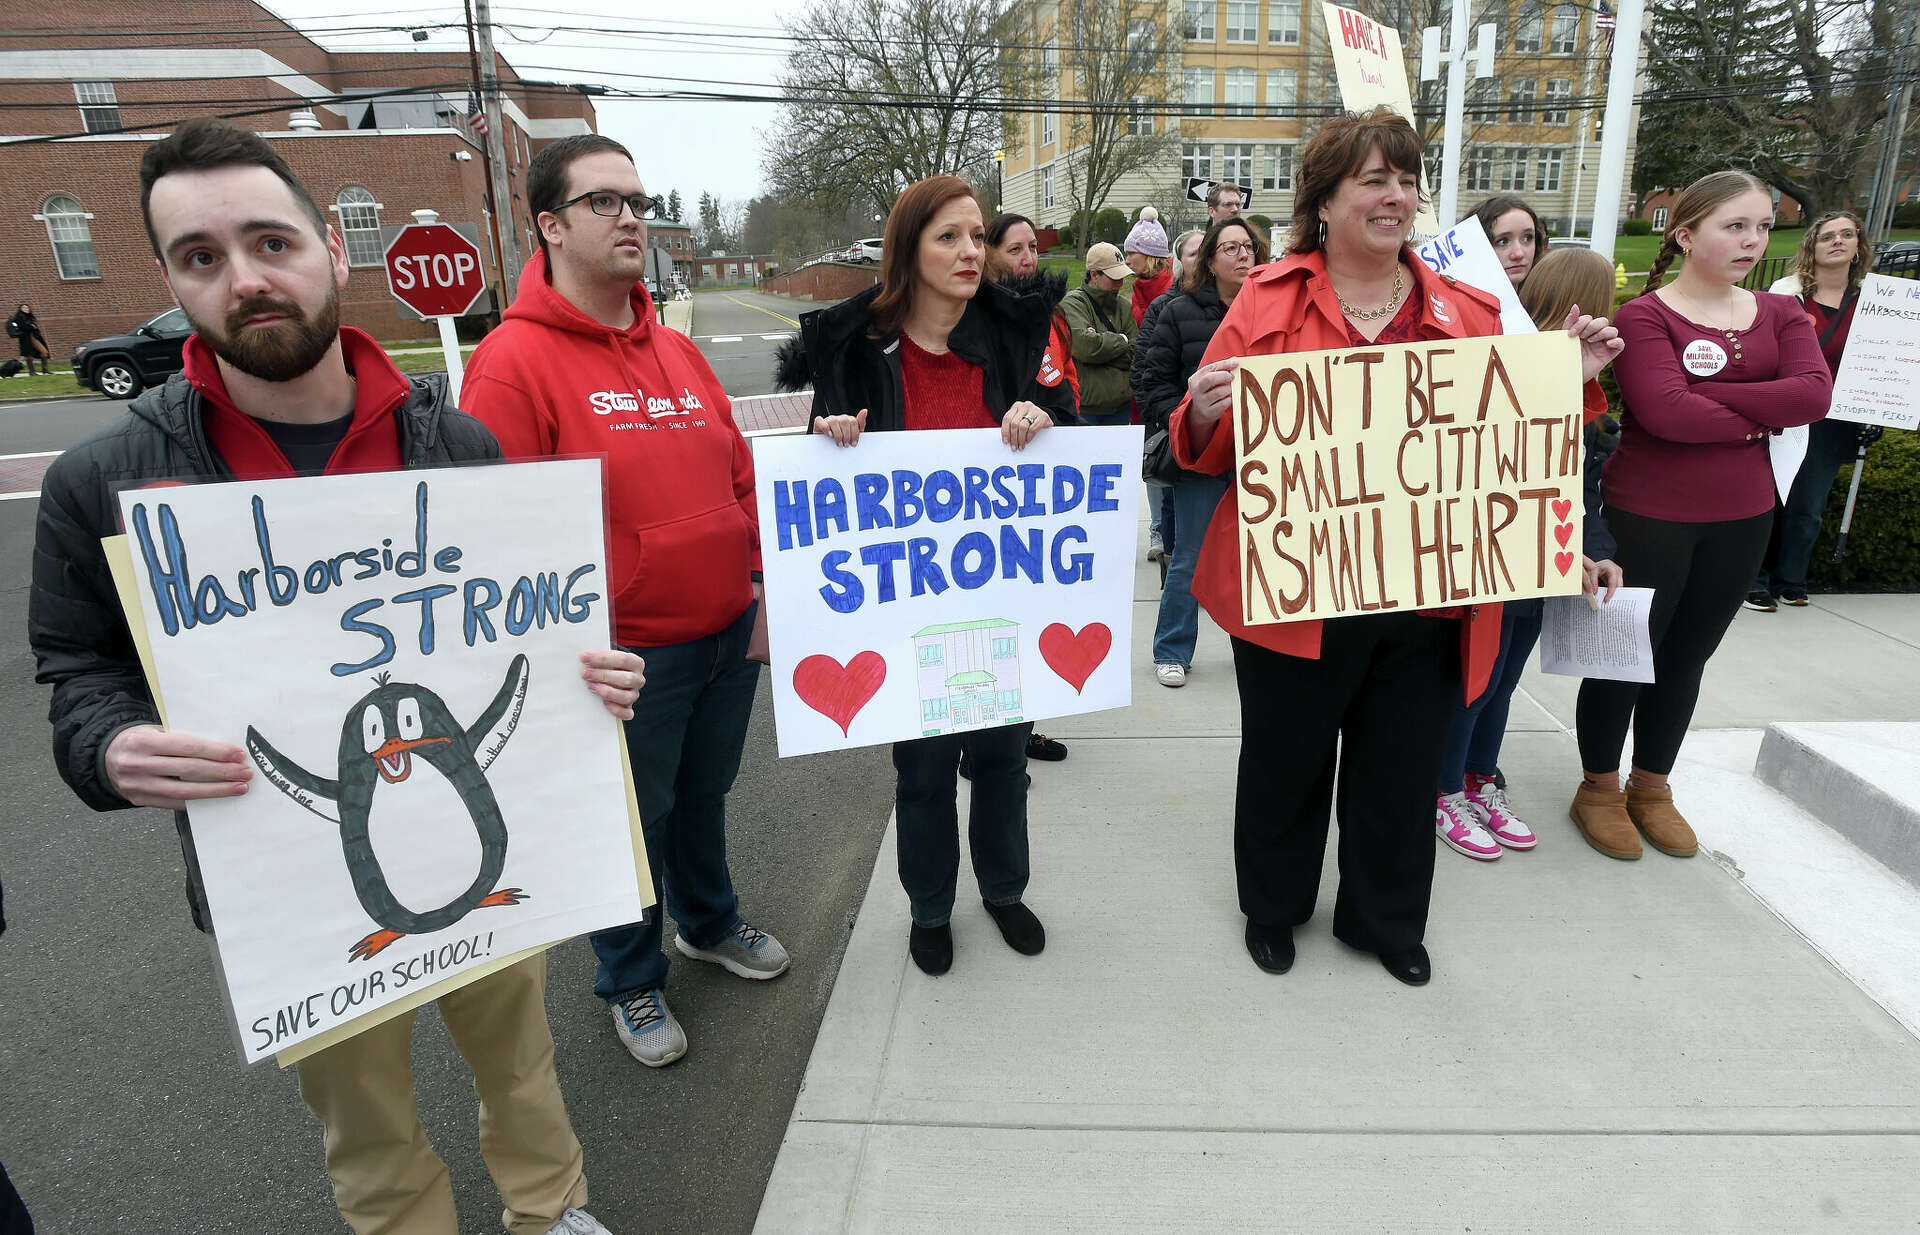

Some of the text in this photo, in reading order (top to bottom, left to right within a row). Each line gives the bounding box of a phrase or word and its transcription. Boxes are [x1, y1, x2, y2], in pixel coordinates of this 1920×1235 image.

[1338, 8, 1388, 61] HAVE A
[394, 252, 475, 290] STOP
[1421, 230, 1464, 273] SAVE
[1690, 361, 1719, 369] SCHOOLS
[589, 390, 638, 415] Stew
[609, 422, 634, 431] FARM
[635, 422, 658, 431] FRESH
[668, 421, 688, 430] SINCE
[1239, 344, 1525, 457] DON'T BE A
[1882, 410, 1914, 421] FIRST
[1239, 413, 1581, 525] SMALL CITY WITH
[773, 463, 1123, 551] HARBORSIDE
[131, 481, 464, 637] Harborside
[819, 525, 1095, 614] STRONG
[1246, 487, 1561, 622] A SMALL HEART
[330, 564, 601, 677] STRONG
[481, 732, 507, 770] without
[266, 768, 291, 793] doing
[292, 785, 314, 808] fine
[251, 931, 494, 1052] SAVE OUR SCHOOL!
